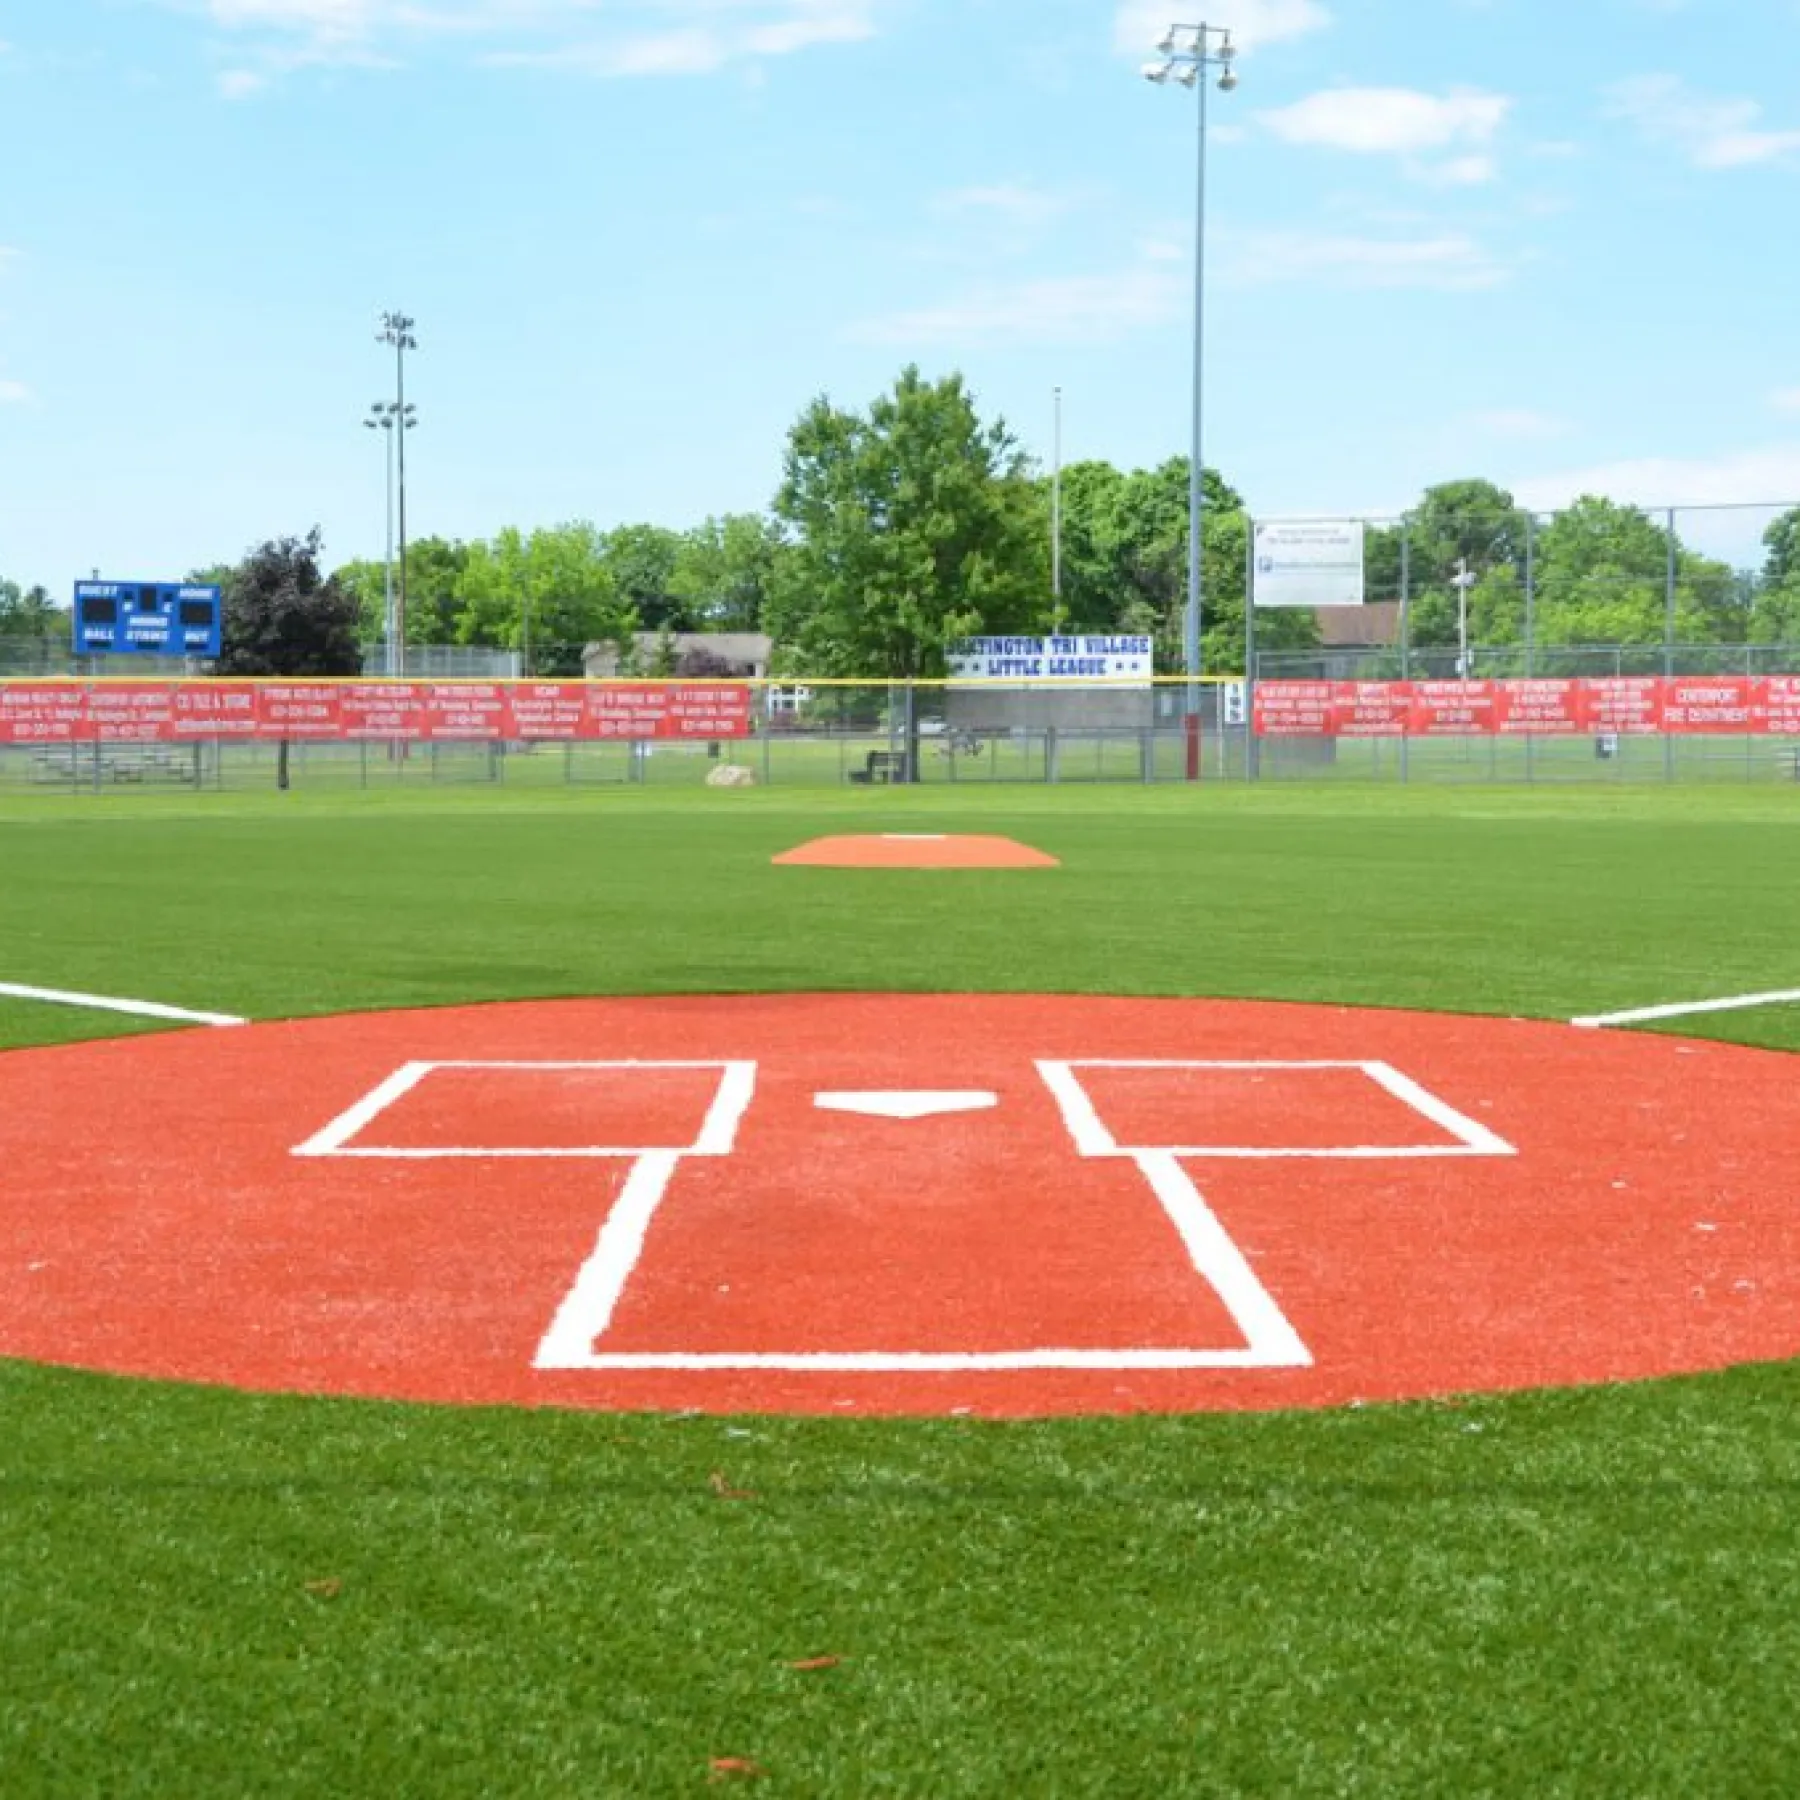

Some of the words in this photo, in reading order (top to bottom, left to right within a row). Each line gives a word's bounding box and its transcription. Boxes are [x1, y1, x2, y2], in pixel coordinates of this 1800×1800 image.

[84, 629, 115, 640] BALL
[1051, 636, 1078, 655] TRI
[1087, 636, 1150, 655] VILLAGE
[988, 657, 1041, 676] LITTLE
[1050, 657, 1107, 676] LEAGUE
